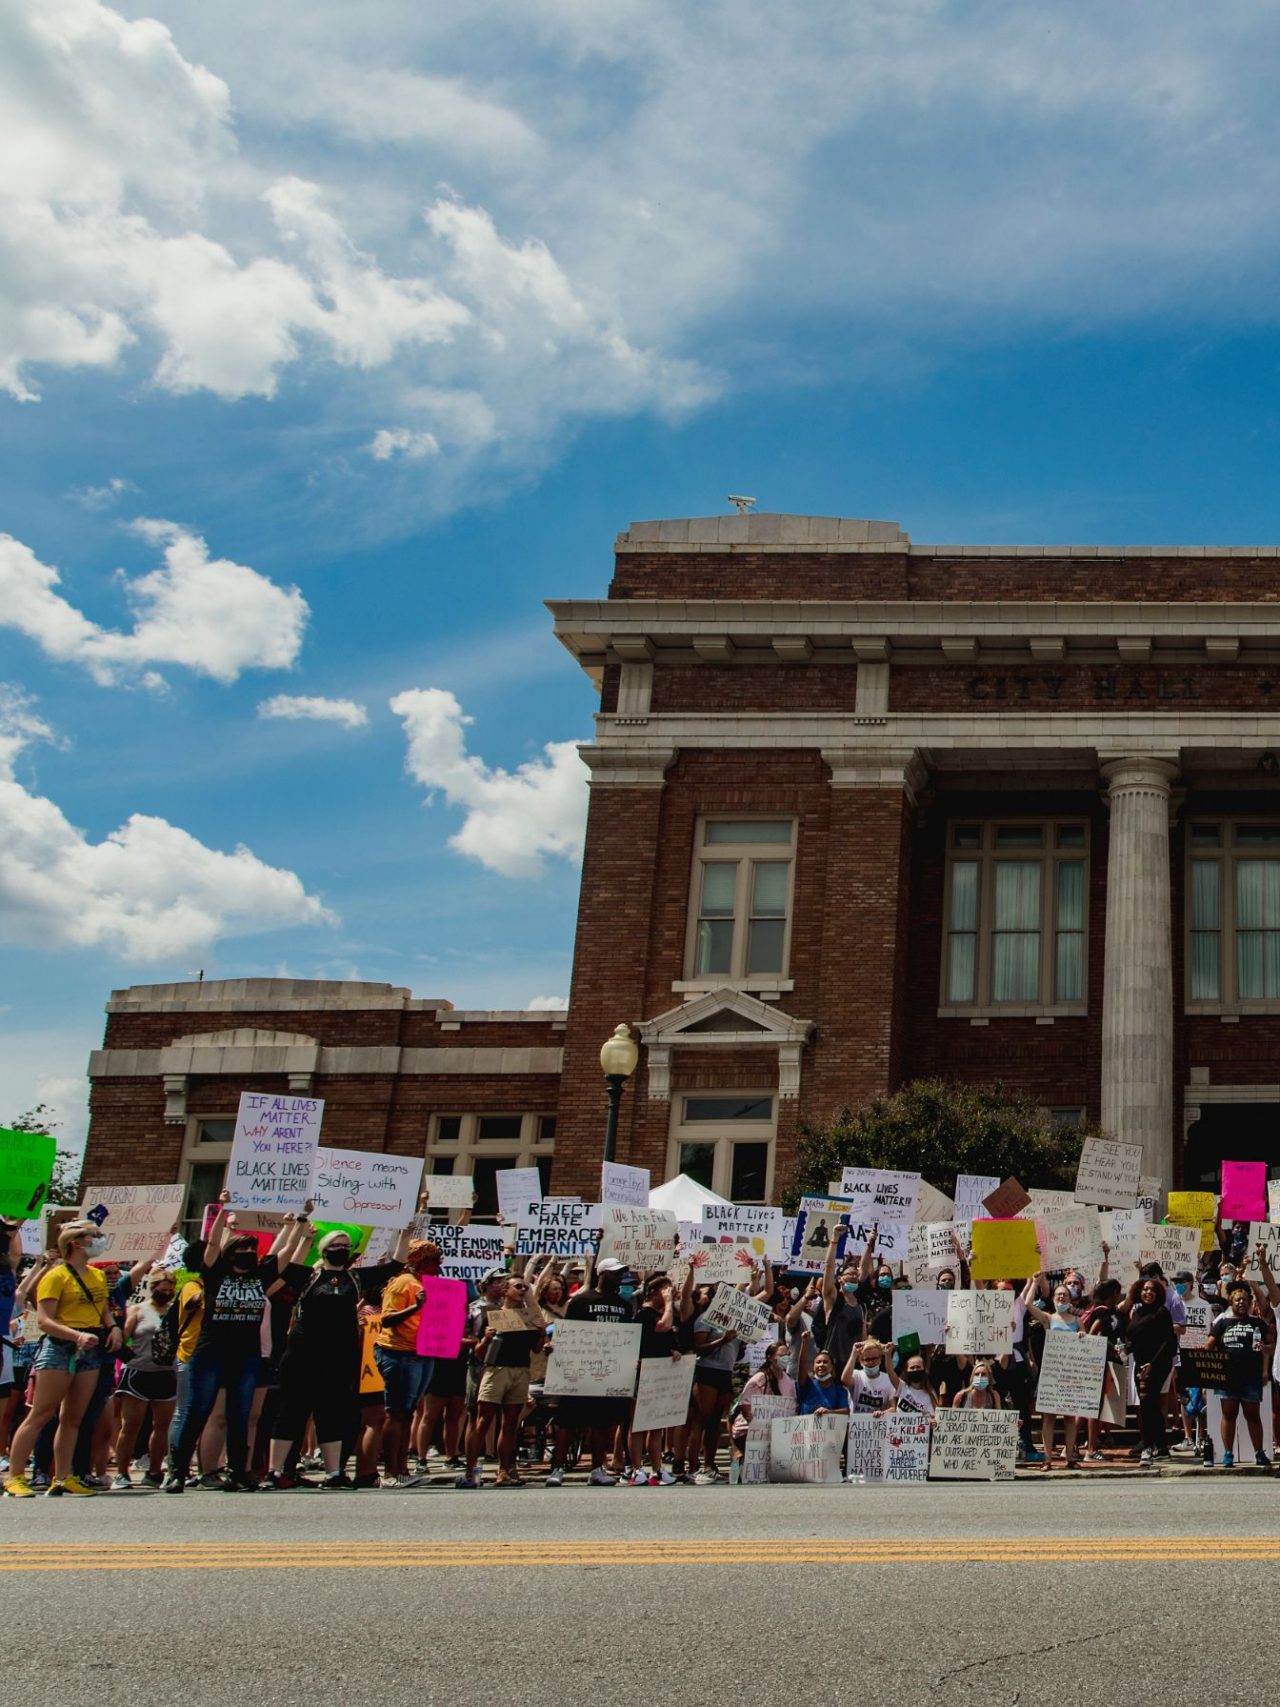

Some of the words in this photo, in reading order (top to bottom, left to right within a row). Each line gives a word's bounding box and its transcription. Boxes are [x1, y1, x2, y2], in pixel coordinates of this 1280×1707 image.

[967, 676, 1066, 699] CITY
[1093, 676, 1200, 699] HALL
[247, 1096, 270, 1109] IF
[272, 1097, 288, 1111] ALL
[292, 1099, 318, 1112] LIVES
[243, 1125, 269, 1137] WHY
[1089, 1140, 1100, 1152] I
[1102, 1143, 1121, 1157] SEE
[1124, 1146, 1142, 1158] YOU
[237, 1160, 277, 1177] BLACK
[282, 1162, 311, 1177] LIVES
[372, 1163, 409, 1175] means
[1082, 1154, 1092, 1165] I
[1095, 1157, 1116, 1168] HEAR
[1120, 1160, 1138, 1172] YOU
[1087, 1170, 1112, 1181] STAND
[318, 1173, 365, 1196] Siding
[368, 1176, 396, 1191] with
[843, 1183, 871, 1194] BLACK
[876, 1183, 899, 1195] LIVES
[89, 1187, 138, 1205] TURN
[146, 1187, 184, 1203] YOUR
[310, 1192, 329, 1208] the
[343, 1197, 402, 1214] Oppressor!
[528, 1203, 594, 1216] REJECT
[706, 1206, 741, 1220] BLACK
[747, 1208, 775, 1220] Lives
[107, 1206, 156, 1226] BACK
[539, 1216, 582, 1226] HATE
[428, 1224, 464, 1238] STOP
[719, 1221, 769, 1234] MATTER!
[120, 1232, 168, 1251] HATE
[518, 1229, 600, 1242] EMBRACE
[427, 1237, 504, 1252] PRETENDING
[516, 1240, 600, 1255] HUMANITY
[932, 1239, 953, 1248] LIVES
[1154, 1240, 1182, 1250] MIEMBRO
[461, 1250, 502, 1262] RACISM
[1161, 1251, 1172, 1260] LOS
[593, 1304, 609, 1312] JUST
[976, 1293, 991, 1312] My
[976, 1310, 995, 1324] Tired
[1186, 1307, 1207, 1316] THEIR
[1188, 1351, 1230, 1360] LEGALIZE
[1195, 1361, 1223, 1370] BEING
[1200, 1372, 1227, 1381] BLACK
[891, 1416, 897, 1425] 9
[898, 1416, 930, 1426] MINUTES
[939, 1410, 979, 1422] JUSTICE
[982, 1411, 1001, 1423] WILL
[1004, 1412, 1019, 1424] NOT
[851, 1421, 866, 1431] ALL
[868, 1421, 887, 1431] LIVES
[944, 1423, 967, 1433] SERVED
[970, 1423, 989, 1434] UNTIL
[991, 1424, 1009, 1434] THOSE
[855, 1440, 882, 1450] UNTIL
[913, 1436, 929, 1444] MAN
[932, 1435, 948, 1445] WHO
[950, 1434, 964, 1445] ARE
[964, 1435, 1001, 1447] UNAFFECTED
[1003, 1436, 1016, 1447] ARE
[855, 1449, 882, 1459] BLACK
[896, 1449, 916, 1459] DAYS
[932, 1446, 942, 1456] AS
[945, 1446, 978, 1457] OUTRAGED
[980, 1448, 990, 1458] AS
[854, 1459, 883, 1468] LIVES
[890, 1458, 916, 1467] ARREST
[943, 1459, 958, 1470] WHO
[851, 1467, 884, 1478] MATTER
[886, 1469, 930, 1481] MURDERER
